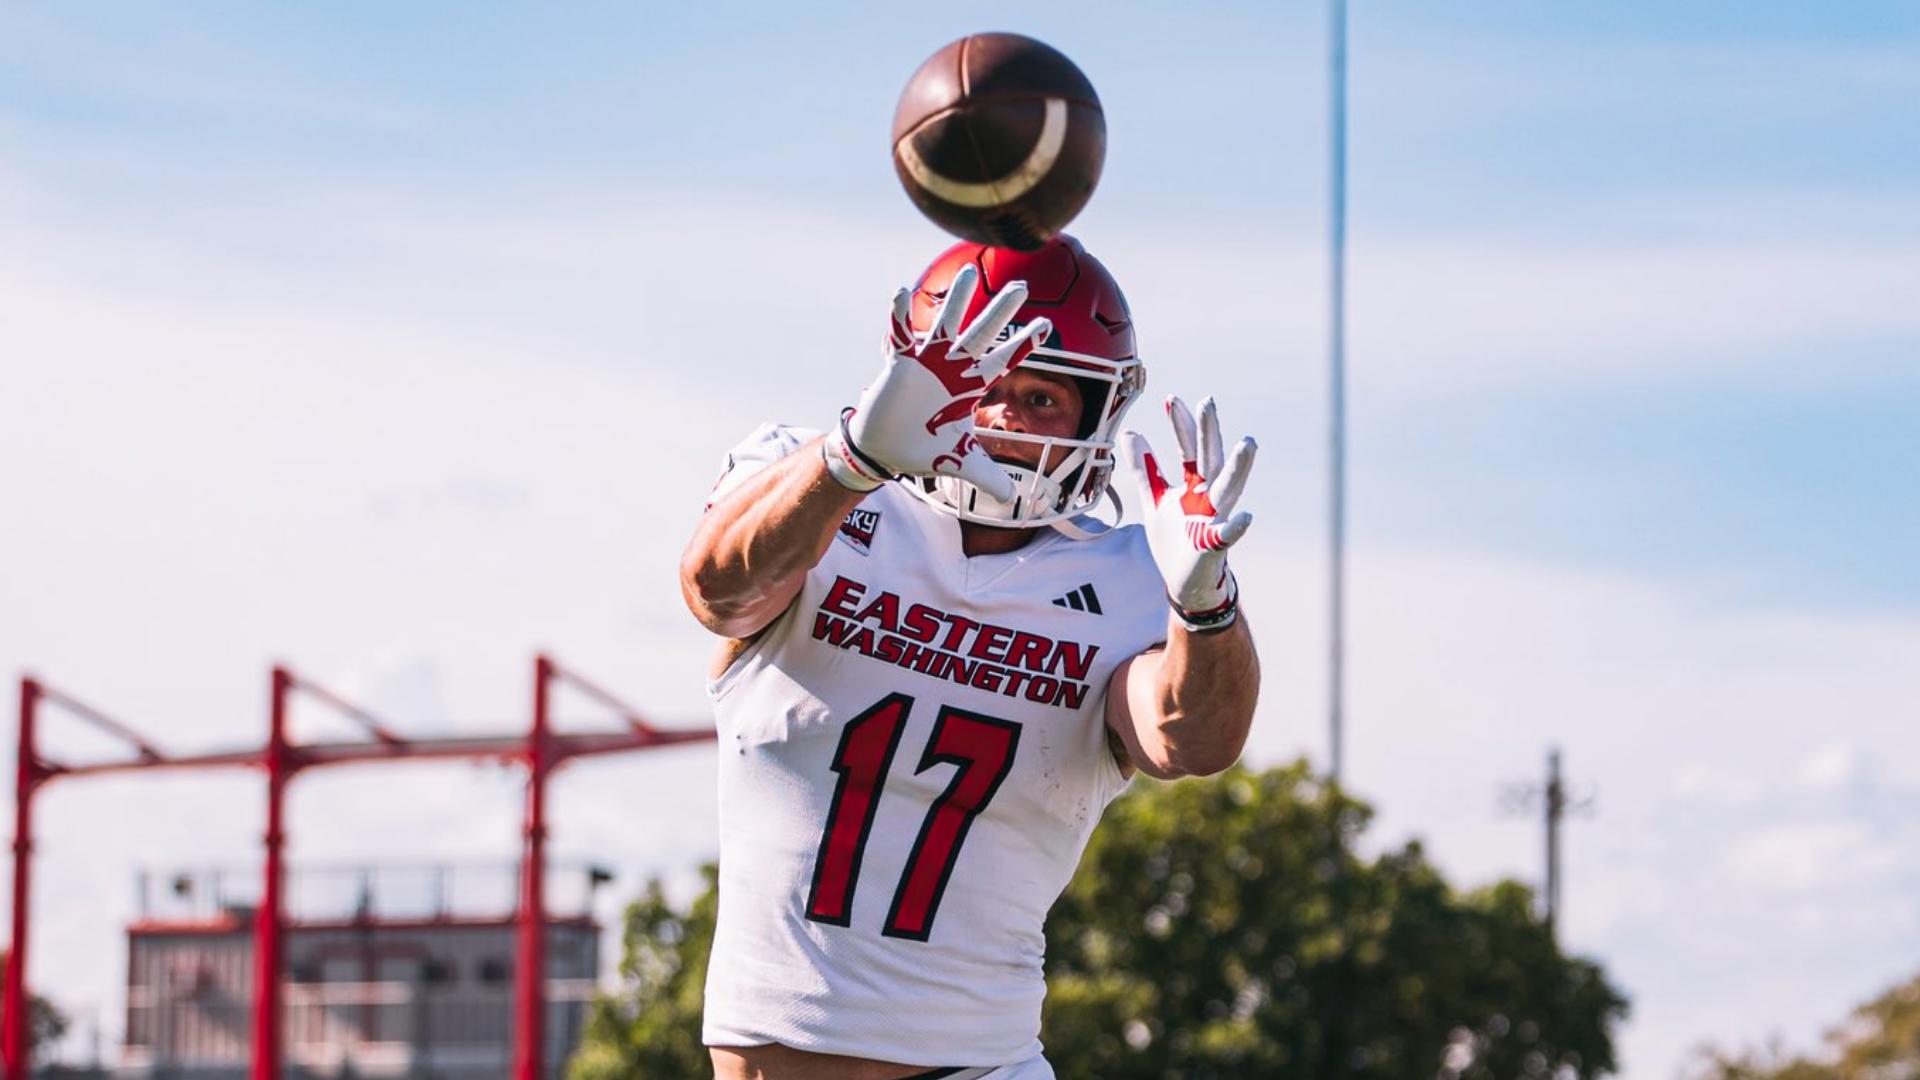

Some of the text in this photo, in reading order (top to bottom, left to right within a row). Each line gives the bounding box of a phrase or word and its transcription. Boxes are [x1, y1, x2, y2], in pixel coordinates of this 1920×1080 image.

[811, 611, 1090, 710] WASHINGTON
[819, 574, 1100, 681] EASTERN
[804, 691, 1023, 942] 17
